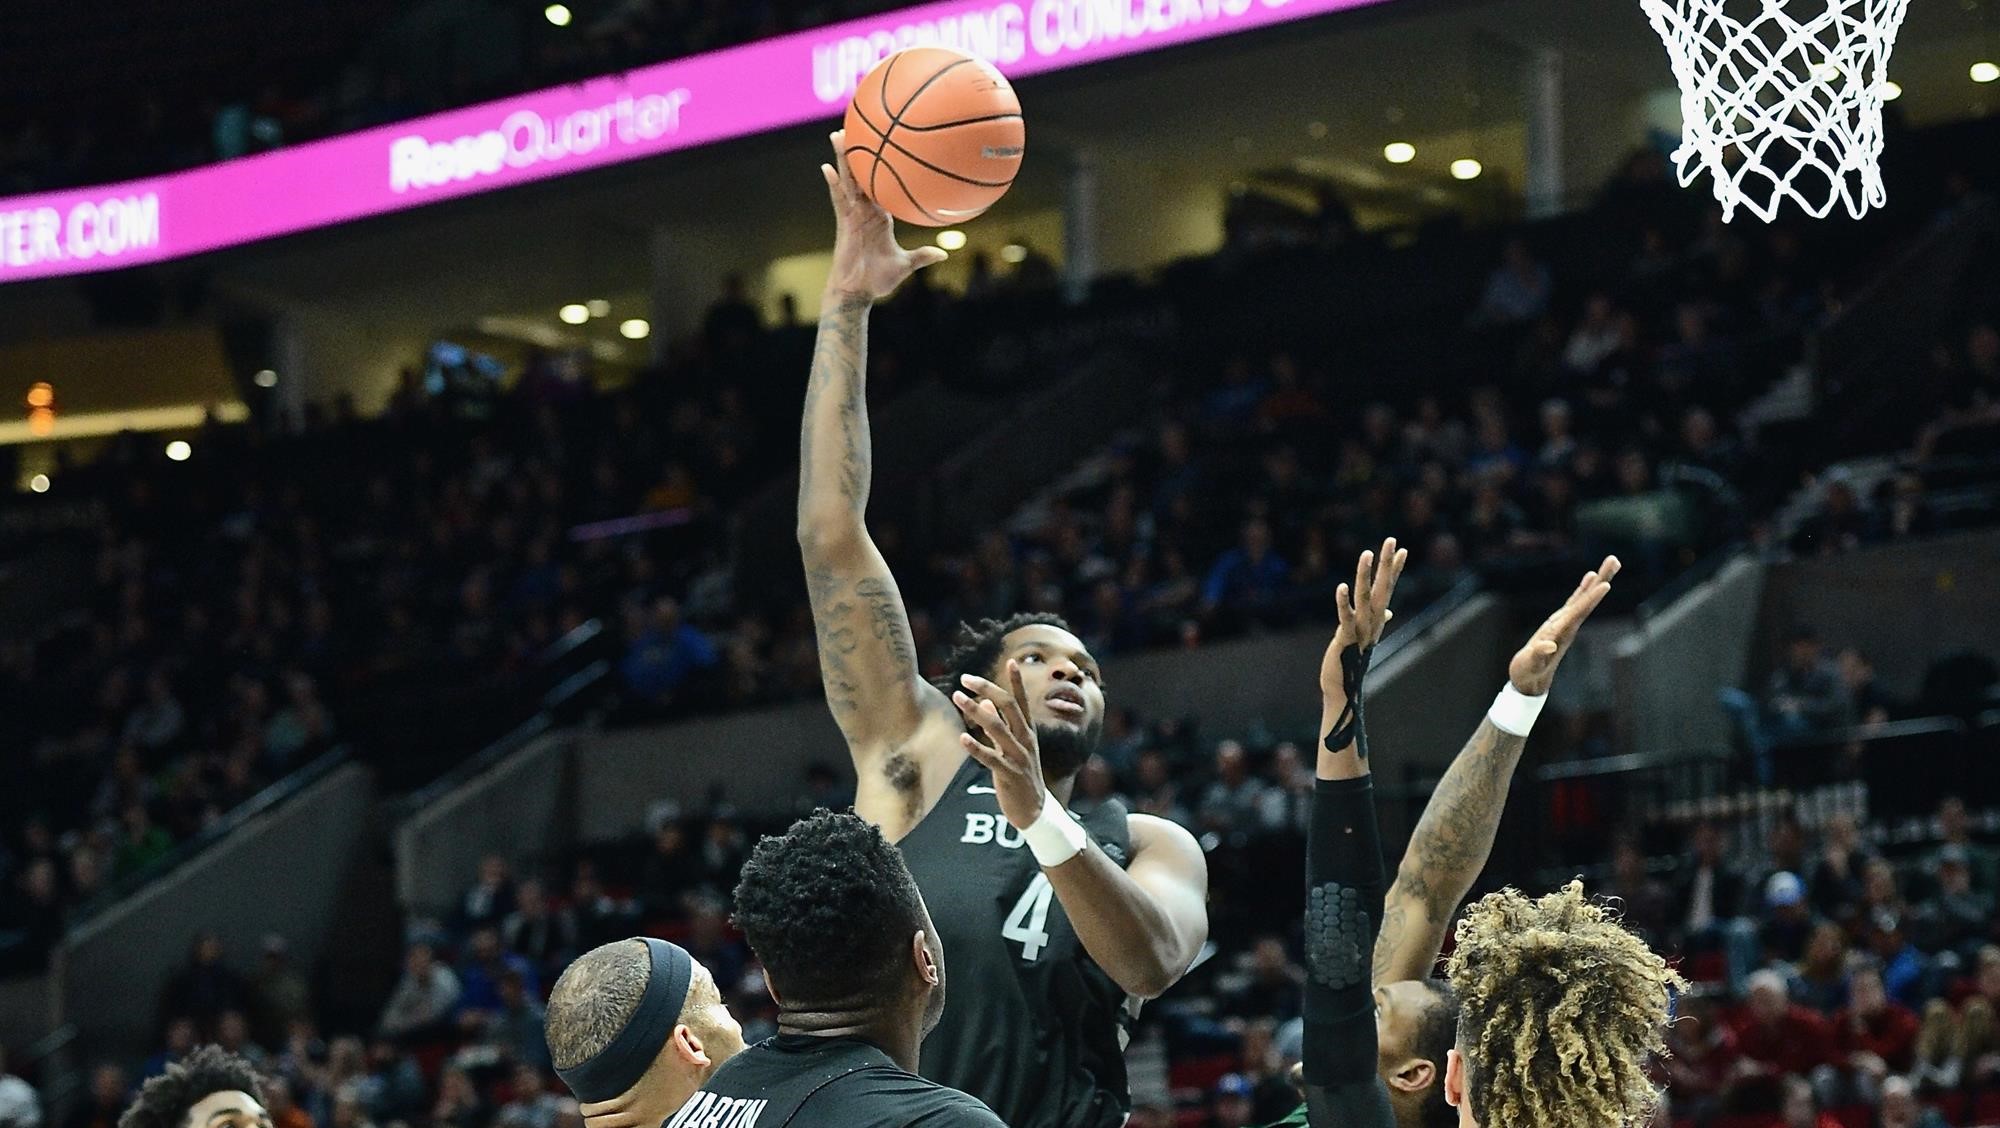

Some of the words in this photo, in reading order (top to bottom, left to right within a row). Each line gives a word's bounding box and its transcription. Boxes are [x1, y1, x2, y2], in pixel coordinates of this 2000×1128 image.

[1029, 0, 1251, 56] CONCE
[1001, 871, 1054, 961] 4
[666, 1091, 768, 1128] MARTIN
